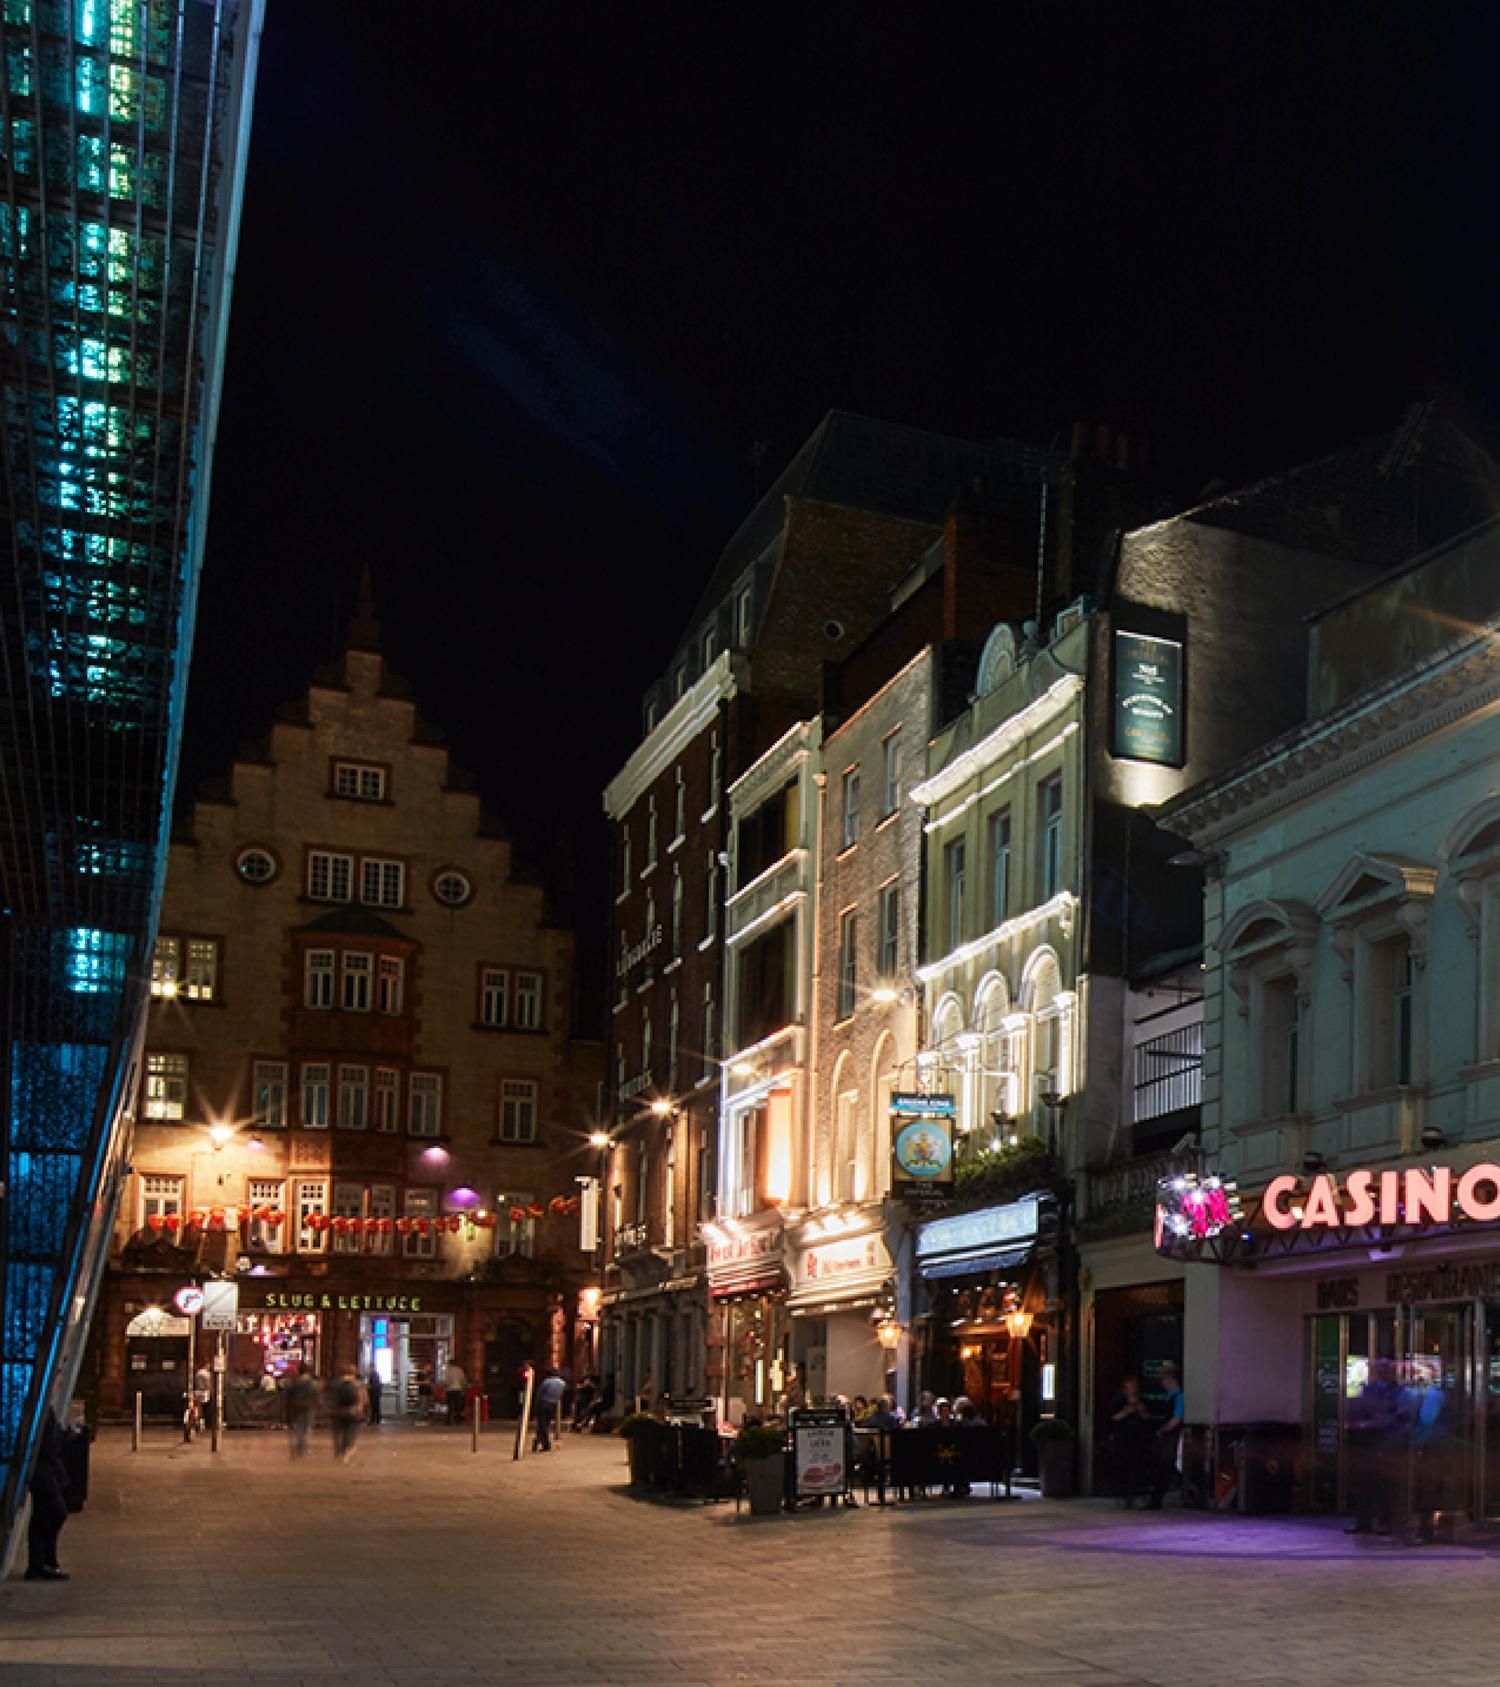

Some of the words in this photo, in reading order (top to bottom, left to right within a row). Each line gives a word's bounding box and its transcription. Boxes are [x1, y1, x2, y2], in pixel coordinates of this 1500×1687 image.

[265, 1293, 314, 1308] SLUG
[320, 1295, 331, 1308] &
[338, 1295, 420, 1311] LETTUCE
[1316, 1276, 1359, 1308] BARS
